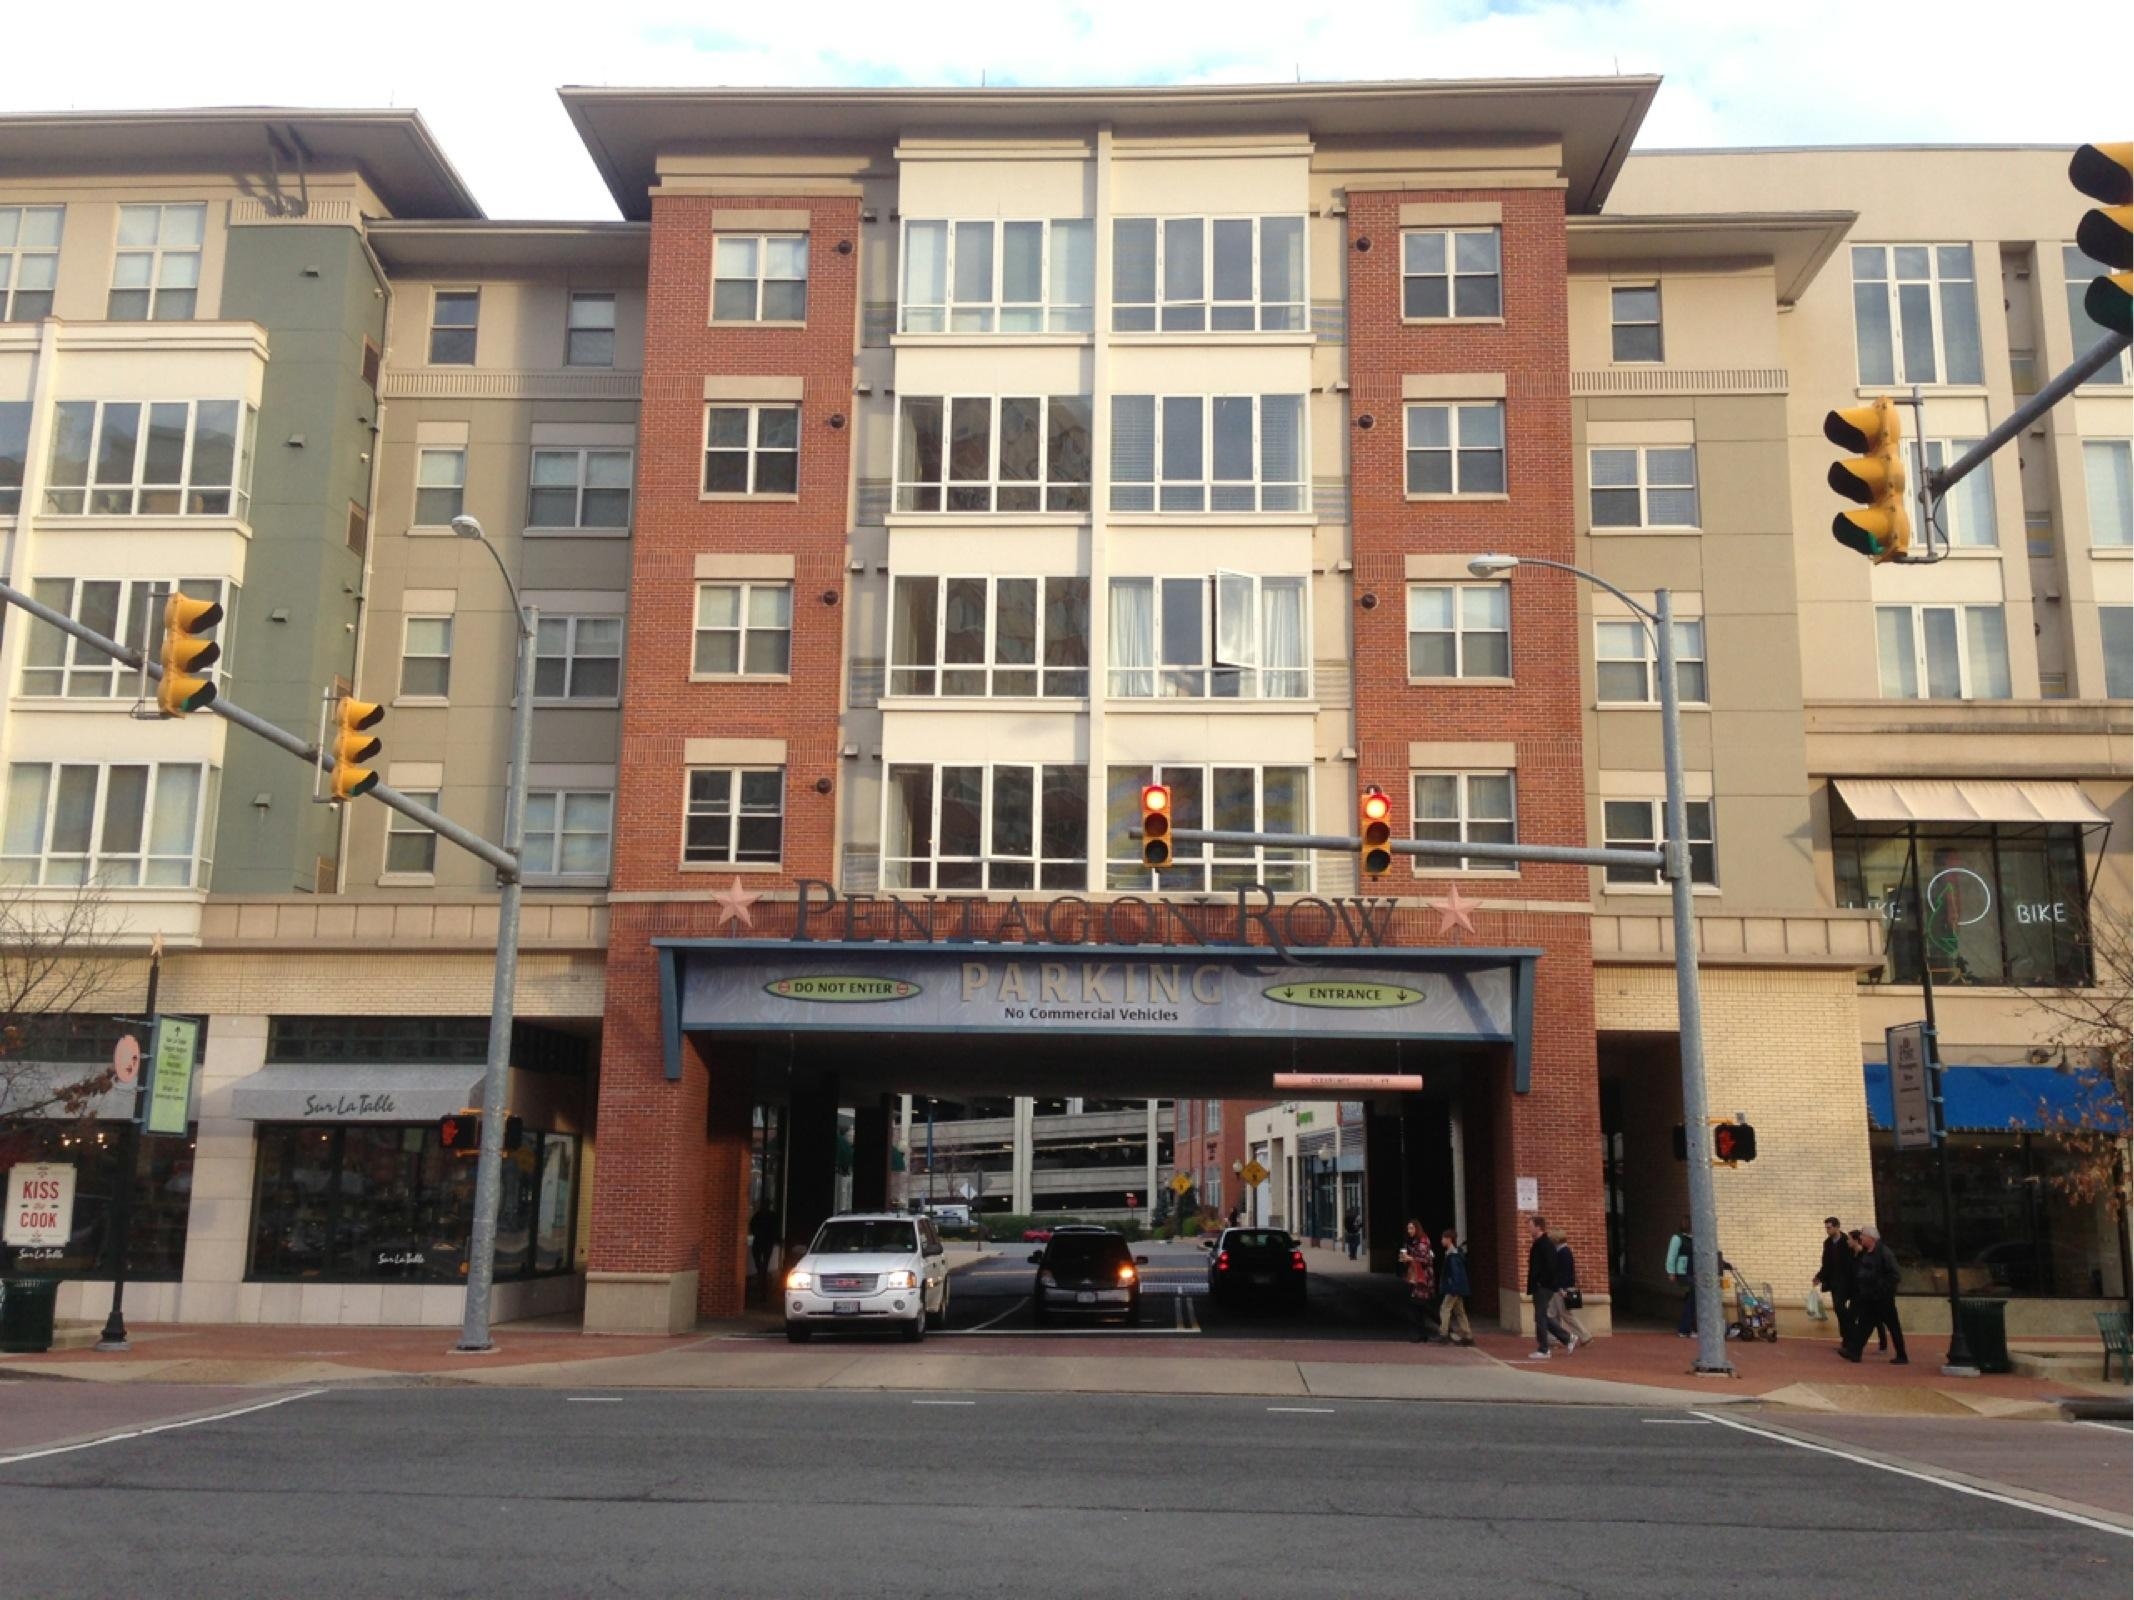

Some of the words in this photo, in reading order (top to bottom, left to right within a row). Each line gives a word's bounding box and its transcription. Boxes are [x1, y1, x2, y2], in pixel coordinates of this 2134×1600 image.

[794, 878, 1209, 946] PENTAGON
[1232, 883, 1399, 966] ROW
[2016, 902, 2067, 923] BIKE
[794, 982, 814, 993] DO
[817, 982, 847, 993] NOT
[849, 983, 893, 994] ENTER
[961, 961, 1223, 1006] PARKING
[1308, 987, 1382, 1001] ENTRANCE
[1004, 1007, 1024, 1019] No
[1028, 1007, 1116, 1020] Commercial
[1119, 1009, 1179, 1021] Vehicles
[303, 1094, 337, 1116] Sur
[337, 1095, 358, 1116] La
[359, 1094, 396, 1116] Table
[22, 1181, 60, 1200] KISS
[20, 1212, 58, 1229] COOK
